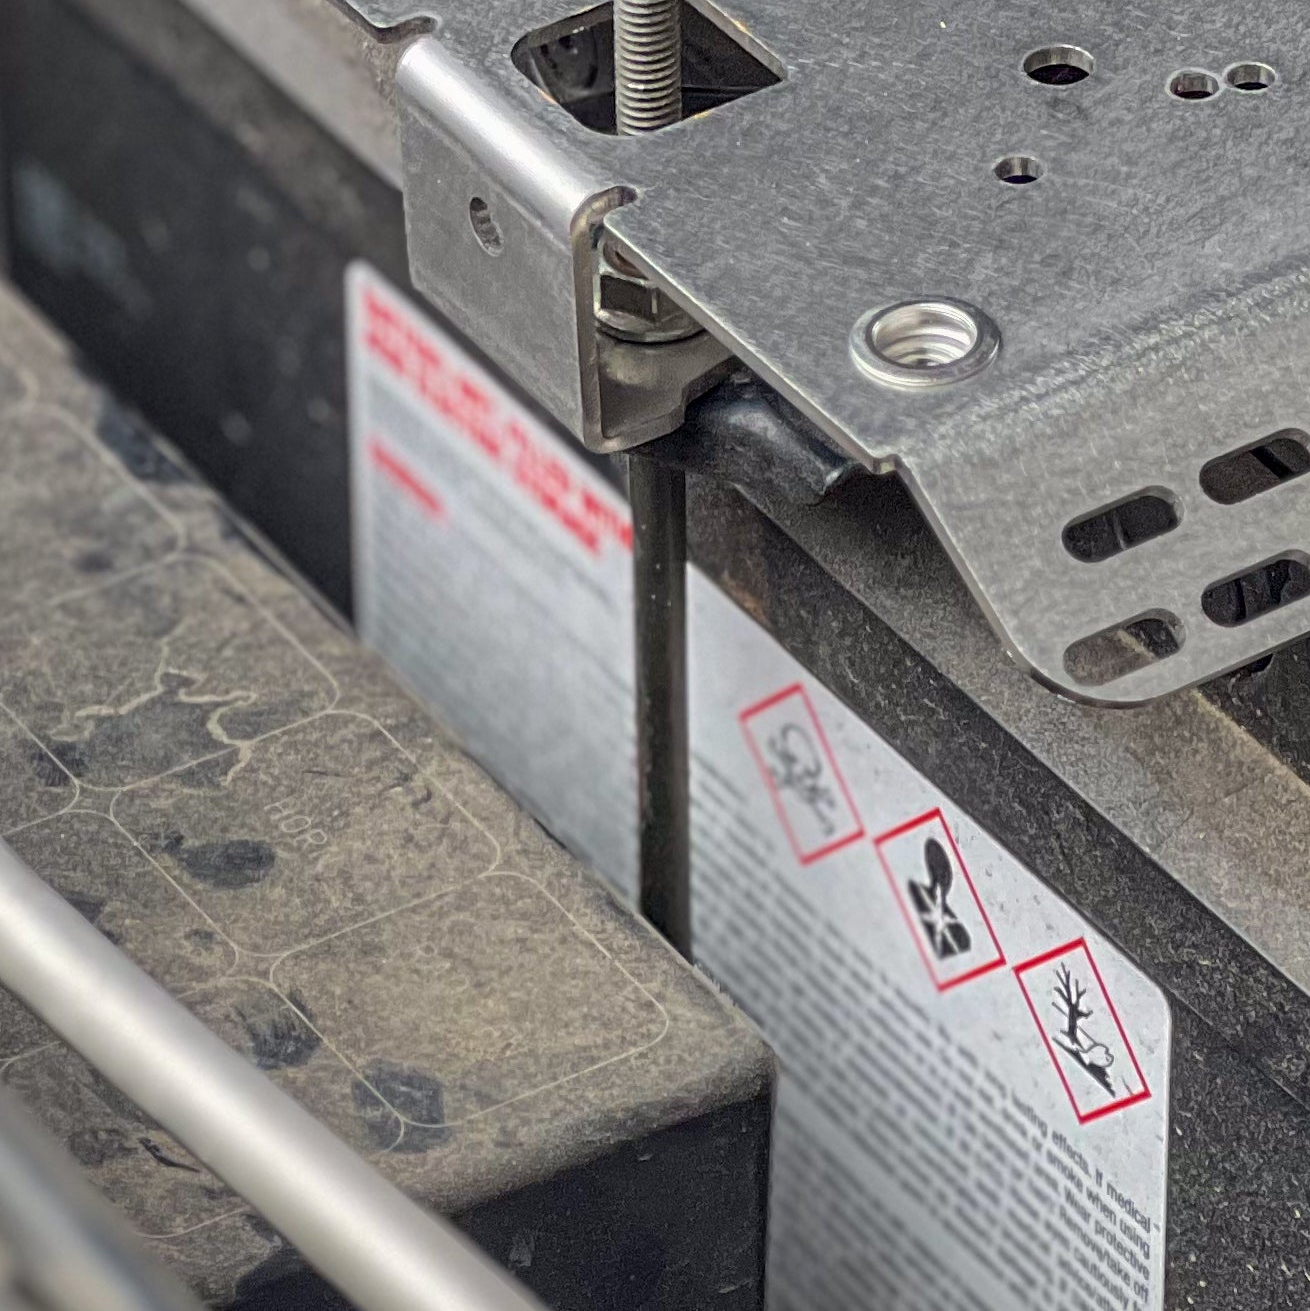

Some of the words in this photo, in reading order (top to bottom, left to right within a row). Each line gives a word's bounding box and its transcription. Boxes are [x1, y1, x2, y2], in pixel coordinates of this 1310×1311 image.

[1046, 1147, 1083, 1196] smoke
[1086, 1183, 1116, 1227] when
[1119, 1215, 1150, 1262] using
[1106, 1178, 1150, 1235] medical
[1094, 1215, 1150, 1283] protective
[1133, 1276, 1149, 1306] off
